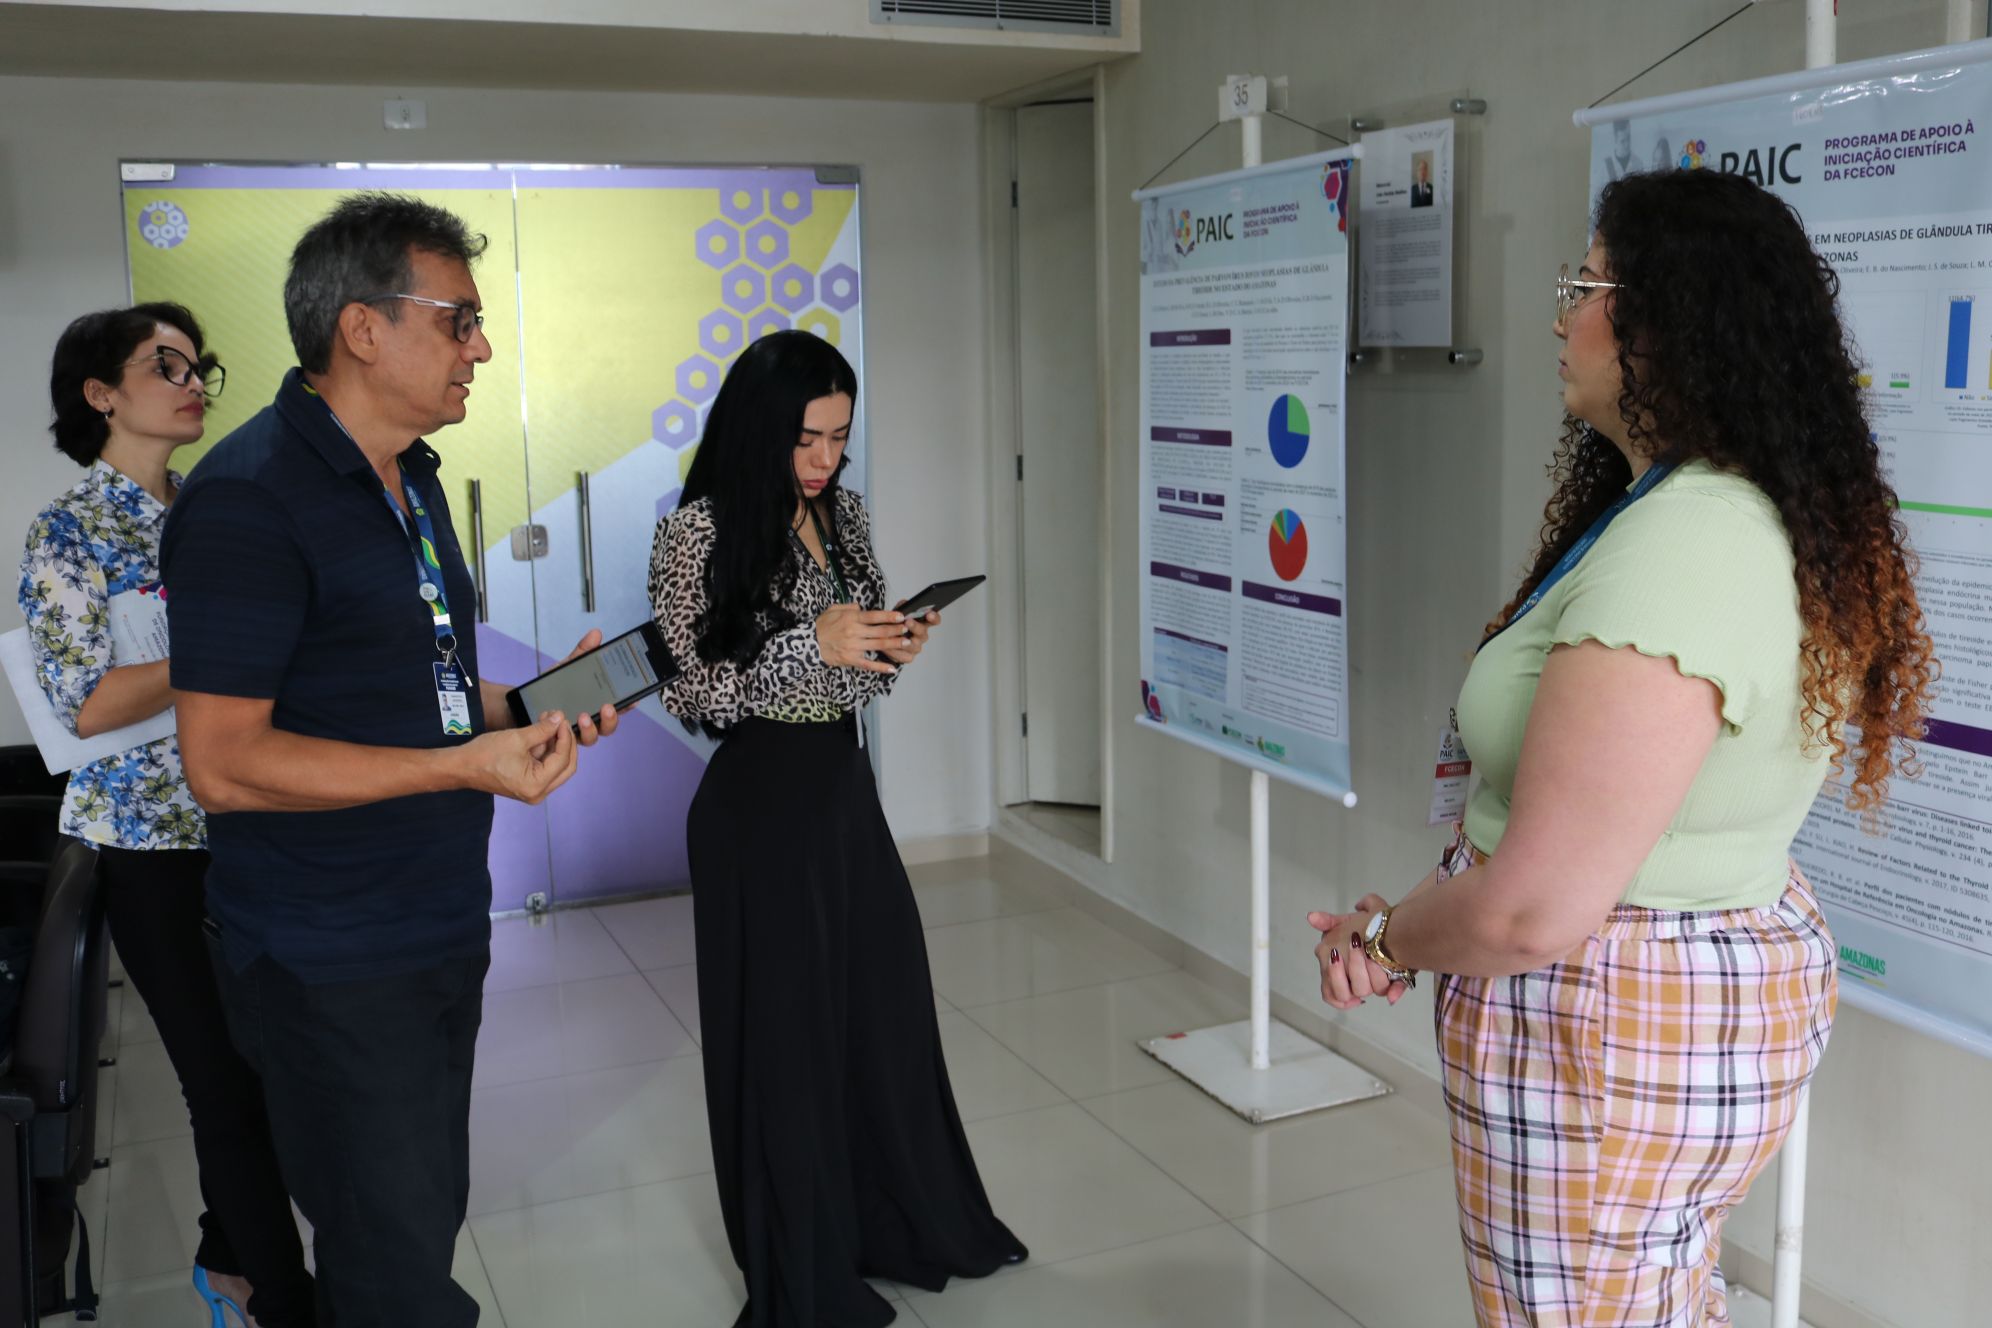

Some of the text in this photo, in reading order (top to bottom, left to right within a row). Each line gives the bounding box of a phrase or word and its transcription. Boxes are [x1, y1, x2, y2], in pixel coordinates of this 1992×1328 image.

[1234, 84, 1248, 105] 35
[1825, 119, 1974, 150] PROGRAMA DE APOIO À
[1721, 143, 1802, 187] PAIC
[1824, 140, 1967, 167] INICIAÇÃO CIENTÍFICA
[1824, 164, 1895, 181] DA FCECON
[1197, 213, 1234, 243] PAIC
[1814, 234, 1831, 244] EM
[1833, 230, 1897, 244] NEOPLASIAS
[1899, 229, 1914, 240] DE
[1916, 223, 1973, 239] GLÂNDULA
[1915, 830, 1927, 839] and
[1930, 812, 1958, 825] Diseases
[1960, 820, 1980, 831] linked
[1913, 863, 1938, 875] Related
[1963, 877, 1989, 890] Thyroid
[1840, 945, 1886, 975] AMAZONAS
